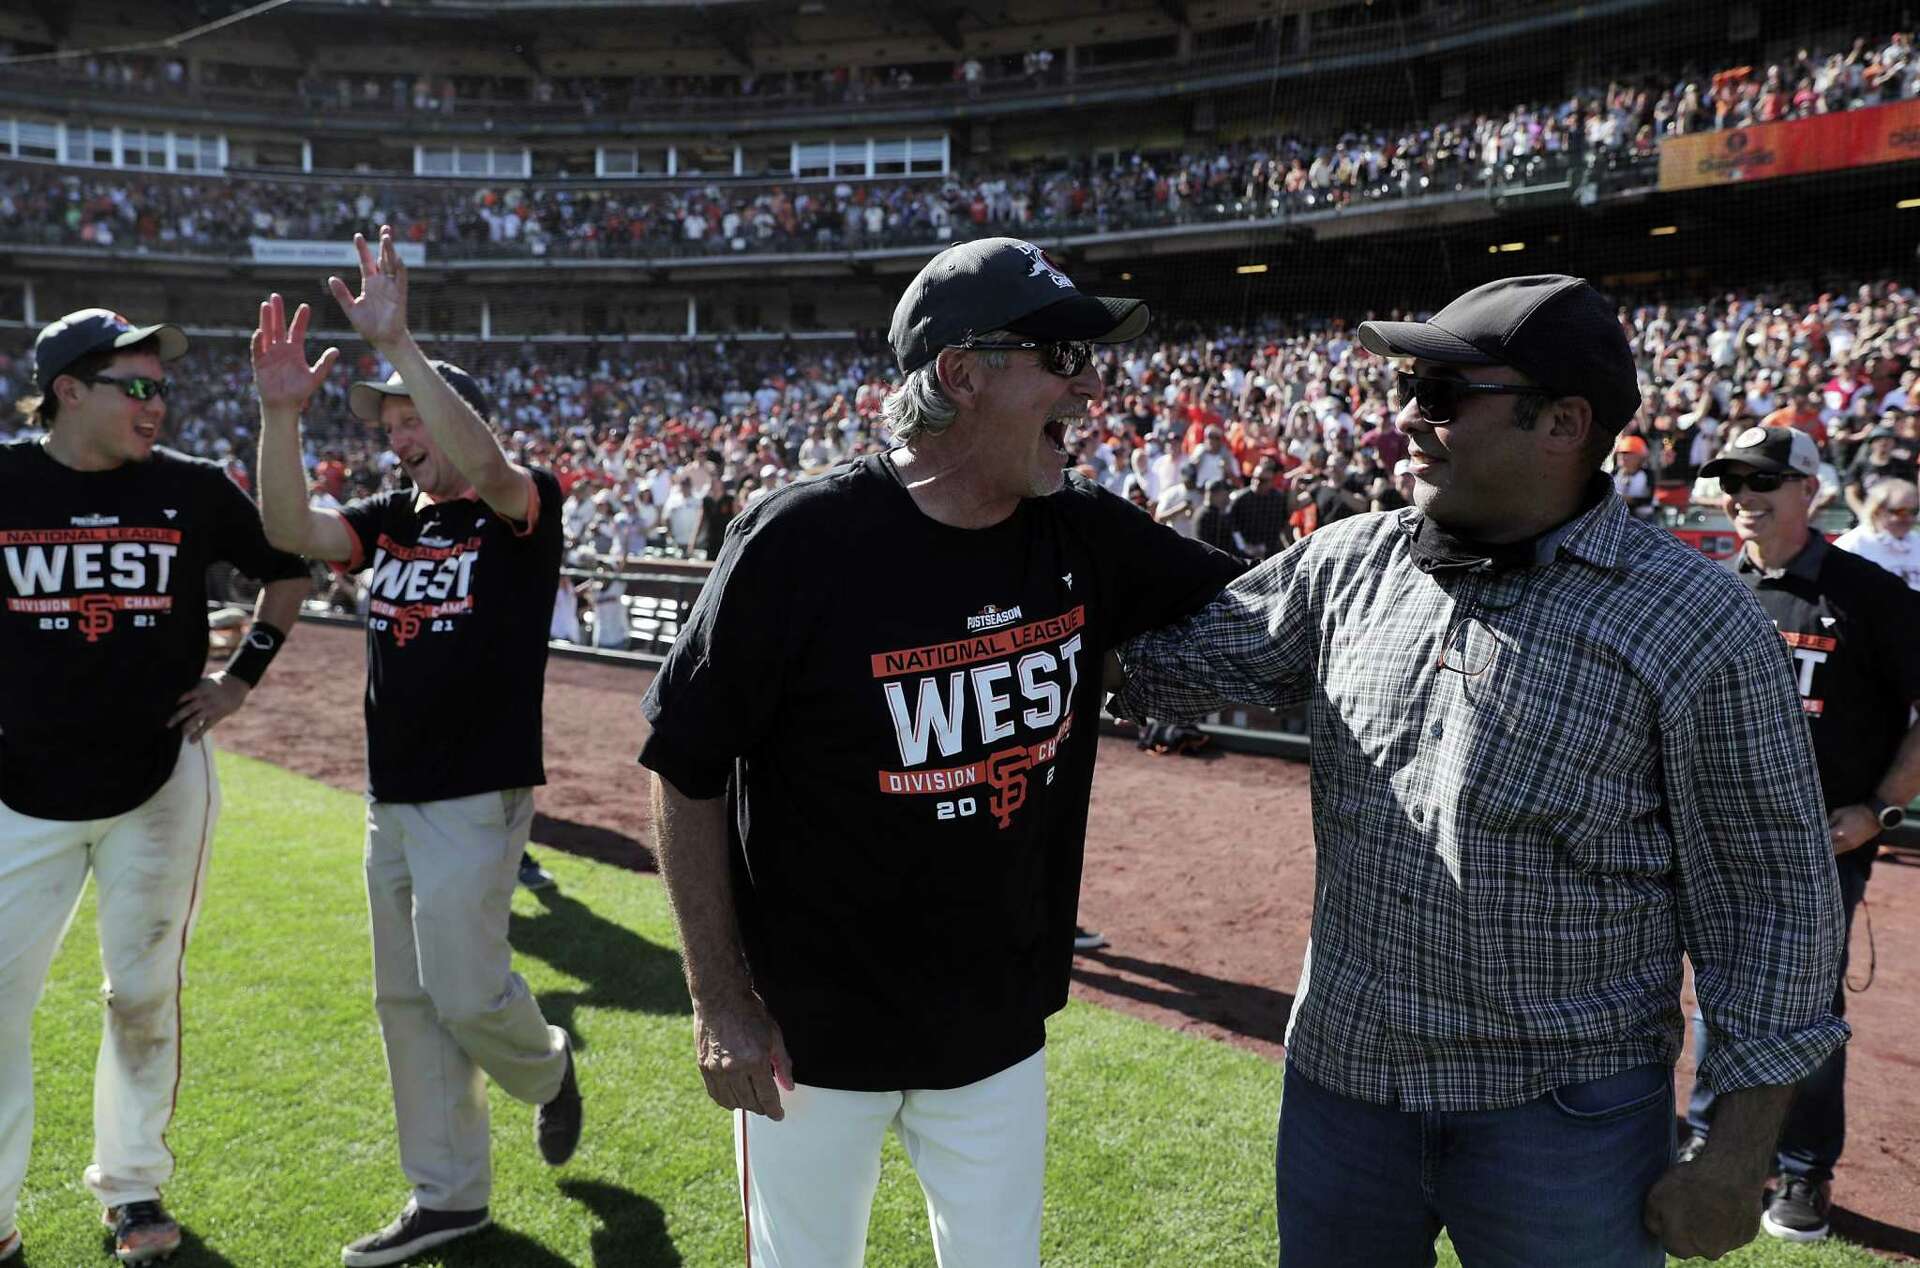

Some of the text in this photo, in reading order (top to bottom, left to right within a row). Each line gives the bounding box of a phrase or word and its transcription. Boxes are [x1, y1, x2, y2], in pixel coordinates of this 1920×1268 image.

[7, 528, 170, 542] NATIONAL LEAGUE
[4, 543, 178, 597] WEST
[371, 547, 479, 601] WEST
[12, 599, 71, 612] DIVISION
[967, 606, 1022, 629] POSTSEASON
[39, 617, 70, 630] 20
[885, 609, 1080, 673] NATIONAL LEAGUE
[883, 633, 1082, 767] WEST
[889, 766, 976, 792] DIVISION
[936, 797, 977, 820] 20
